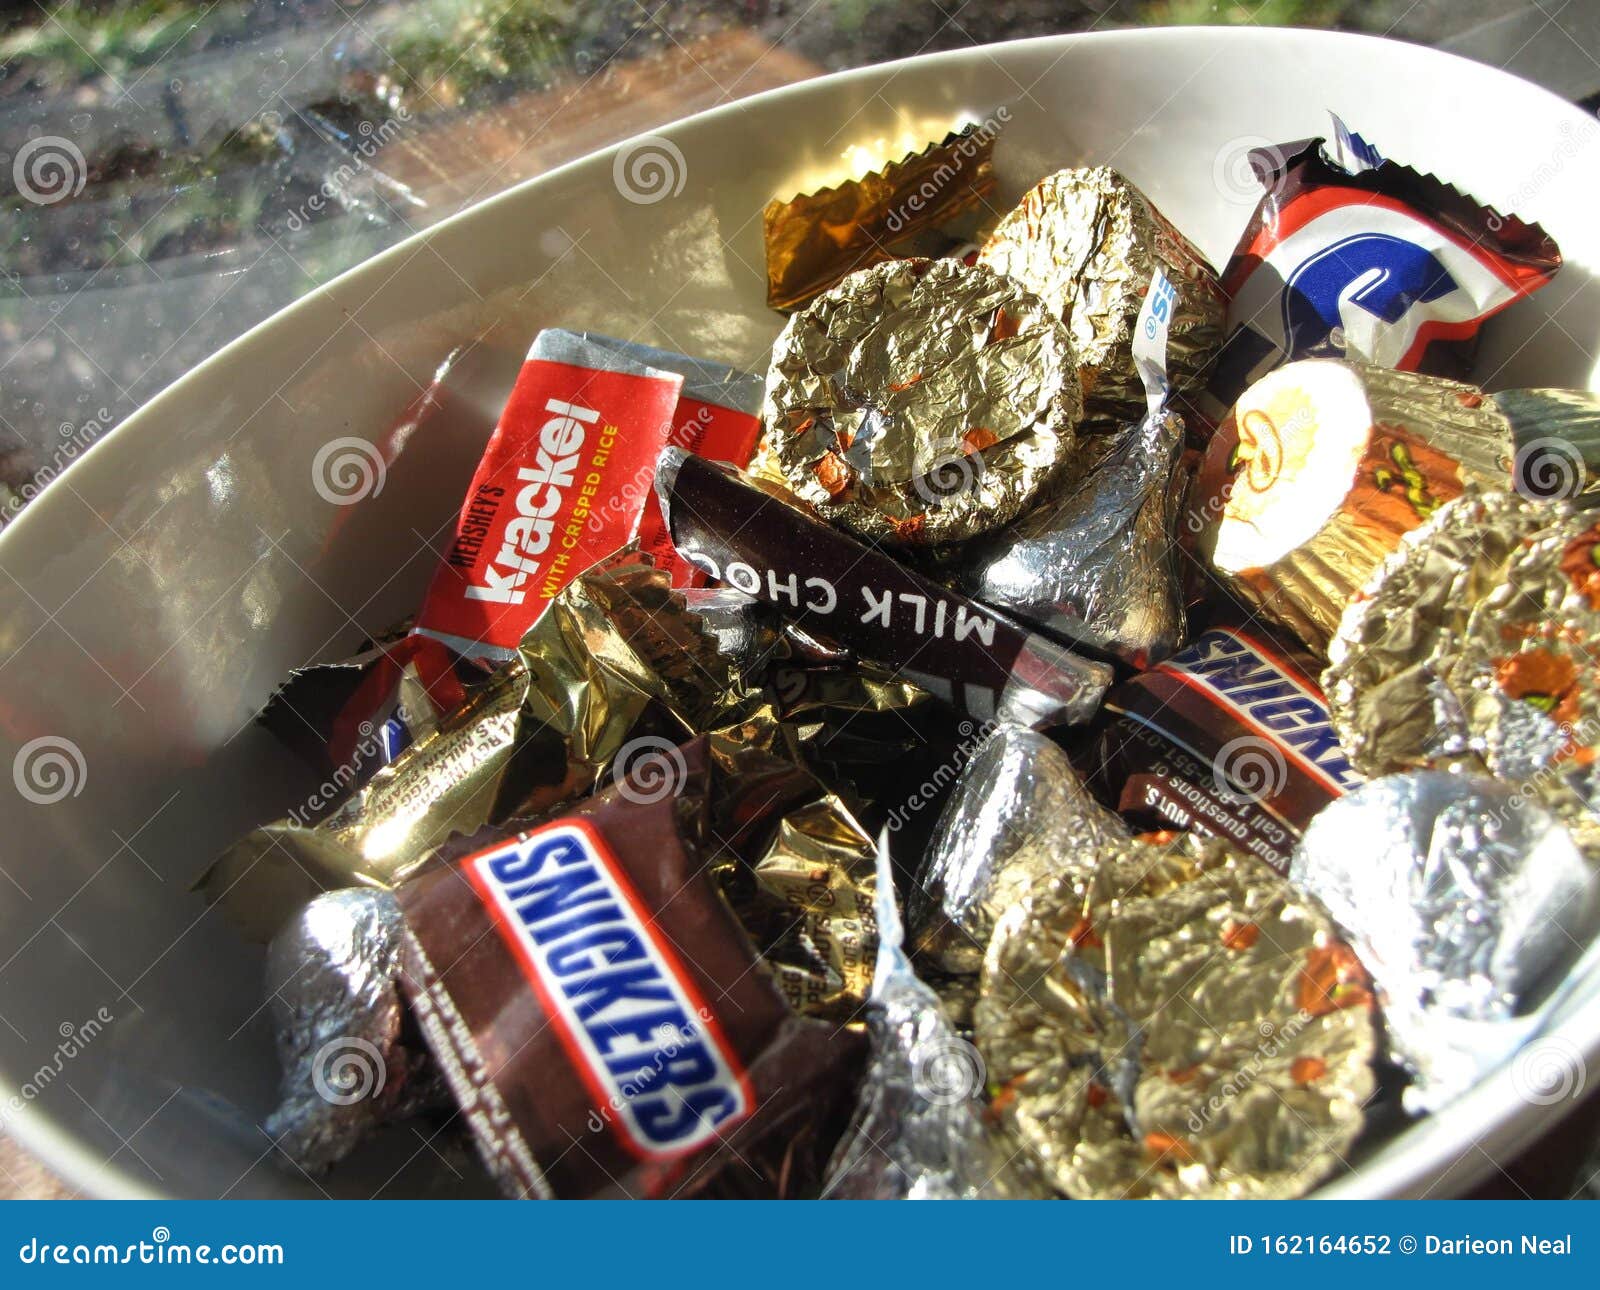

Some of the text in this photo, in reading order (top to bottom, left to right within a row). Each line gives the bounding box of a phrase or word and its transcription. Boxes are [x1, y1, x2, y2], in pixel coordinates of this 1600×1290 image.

[464, 398, 600, 605] krackel
[540, 425, 618, 600] WITH CRISPED RICE
[861, 586, 995, 647] MILK
[1148, 760, 1169, 778] or
[1145, 784, 1190, 826] NUTS.
[1169, 777, 1249, 839] questions
[1250, 814, 1287, 845] Call
[1247, 837, 1292, 872] your
[489, 834, 737, 1143] SNICKERS
